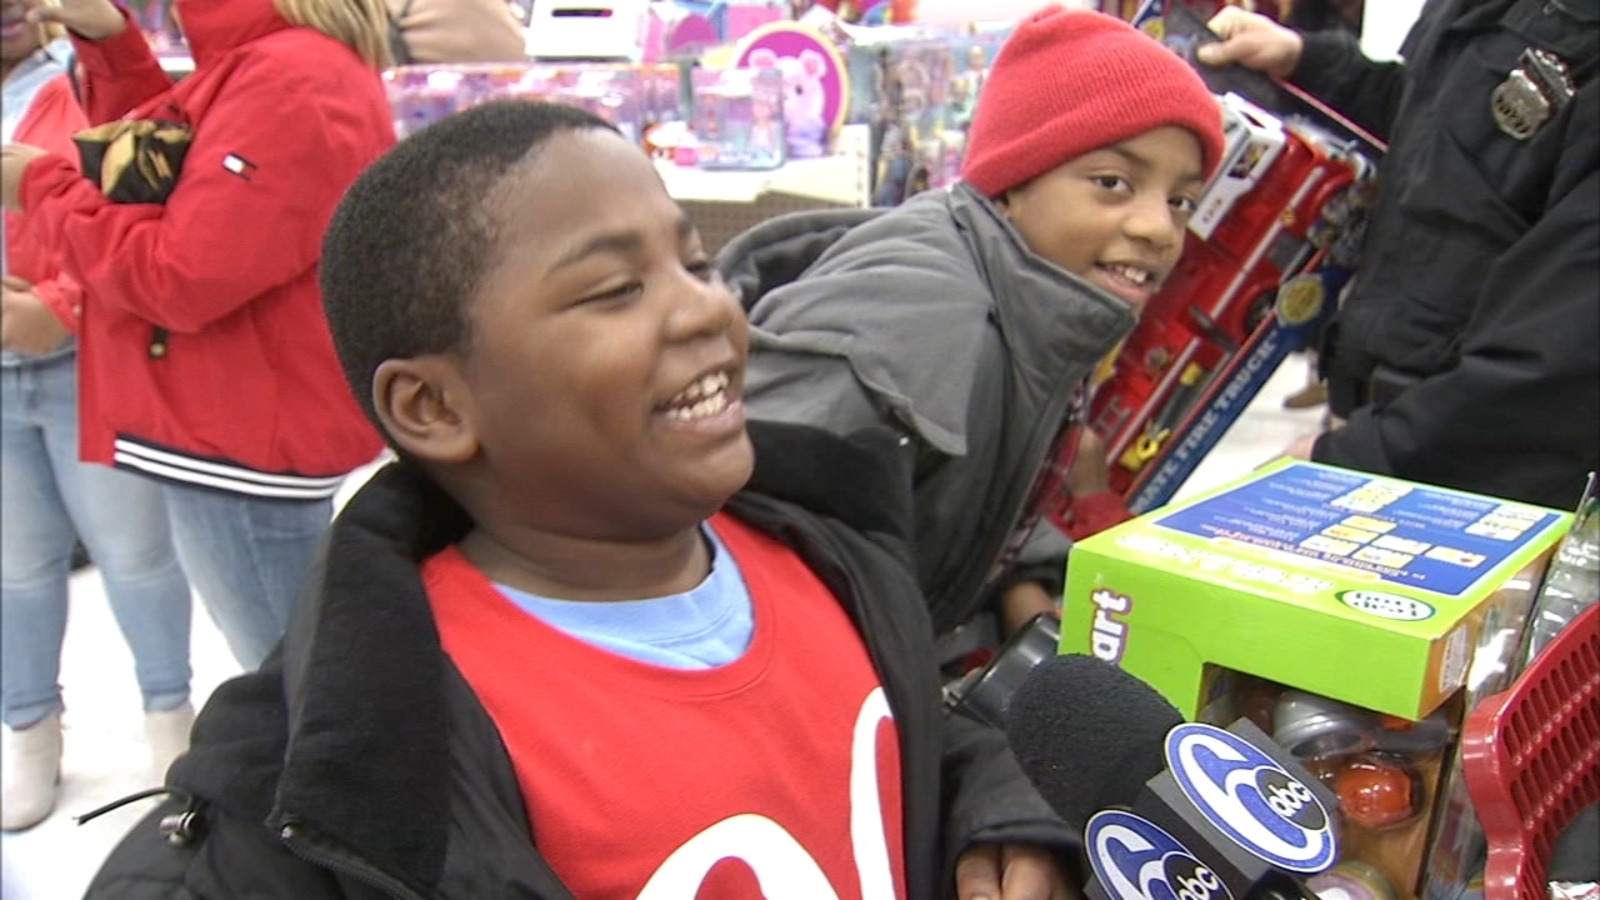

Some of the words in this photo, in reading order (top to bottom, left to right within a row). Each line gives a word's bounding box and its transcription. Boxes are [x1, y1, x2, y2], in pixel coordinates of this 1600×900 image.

[1174, 410, 1219, 460] FIRE
[1213, 338, 1276, 411] TRUCK
[1178, 733, 1324, 861] 6
[1268, 781, 1311, 817] abc
